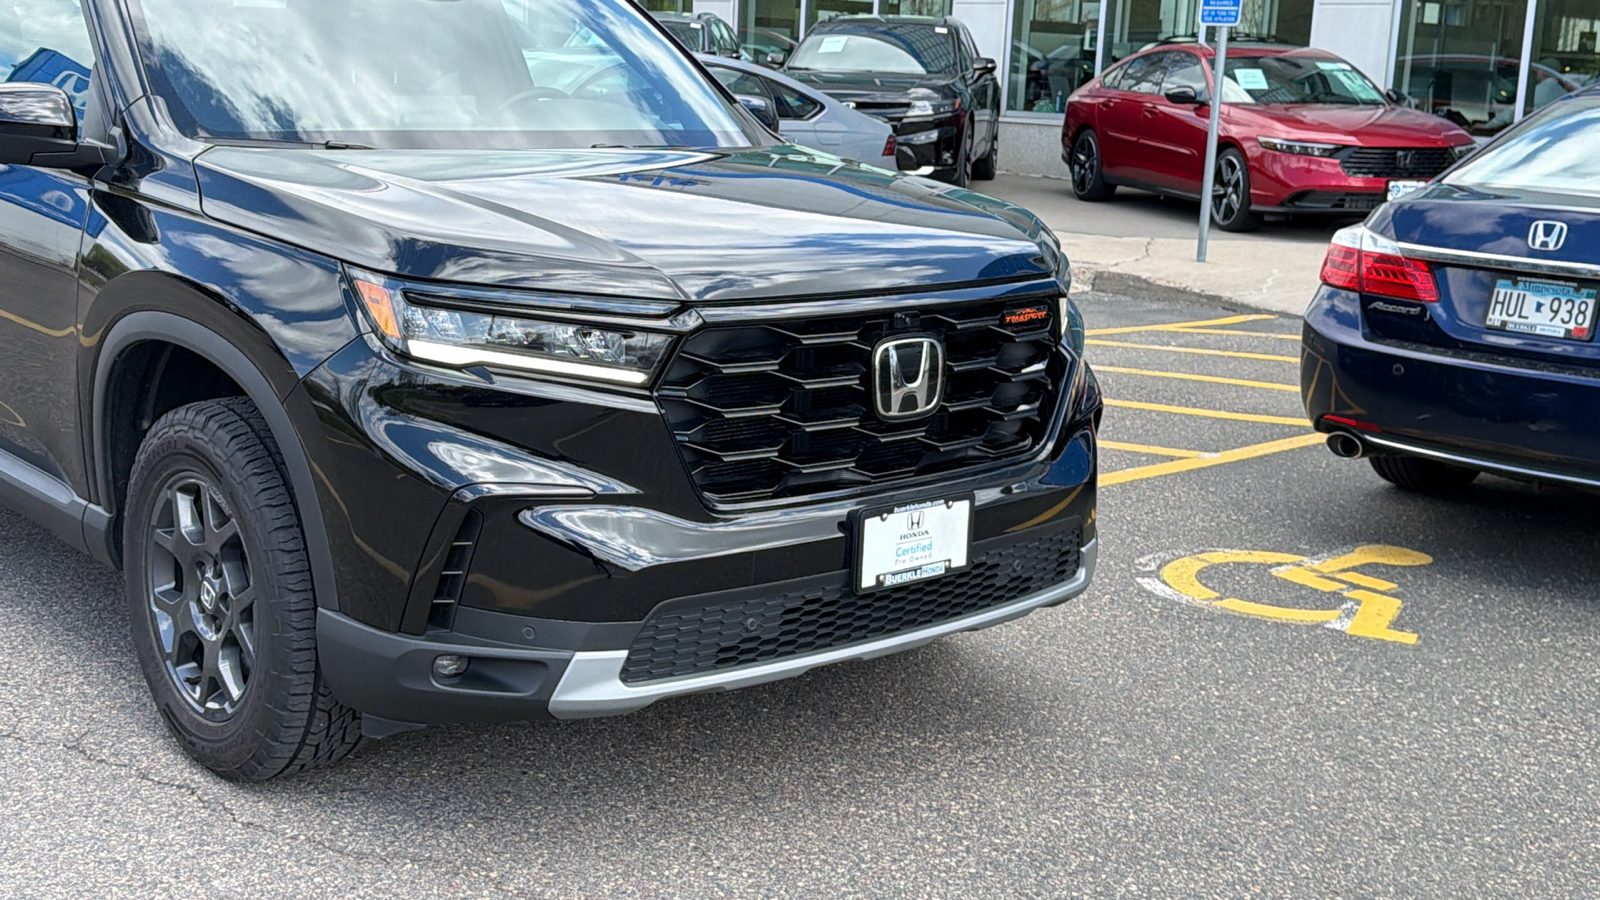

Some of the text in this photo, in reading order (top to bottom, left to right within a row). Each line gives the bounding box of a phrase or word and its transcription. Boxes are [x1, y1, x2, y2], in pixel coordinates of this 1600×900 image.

[1520, 281, 1571, 297] Minnesota
[1367, 301, 1421, 315] Accord
[1491, 290, 1589, 326] HUL 938
[899, 529, 930, 541] HONDA
[896, 541, 932, 557] Certified
[894, 552, 932, 566] Pre Owned
